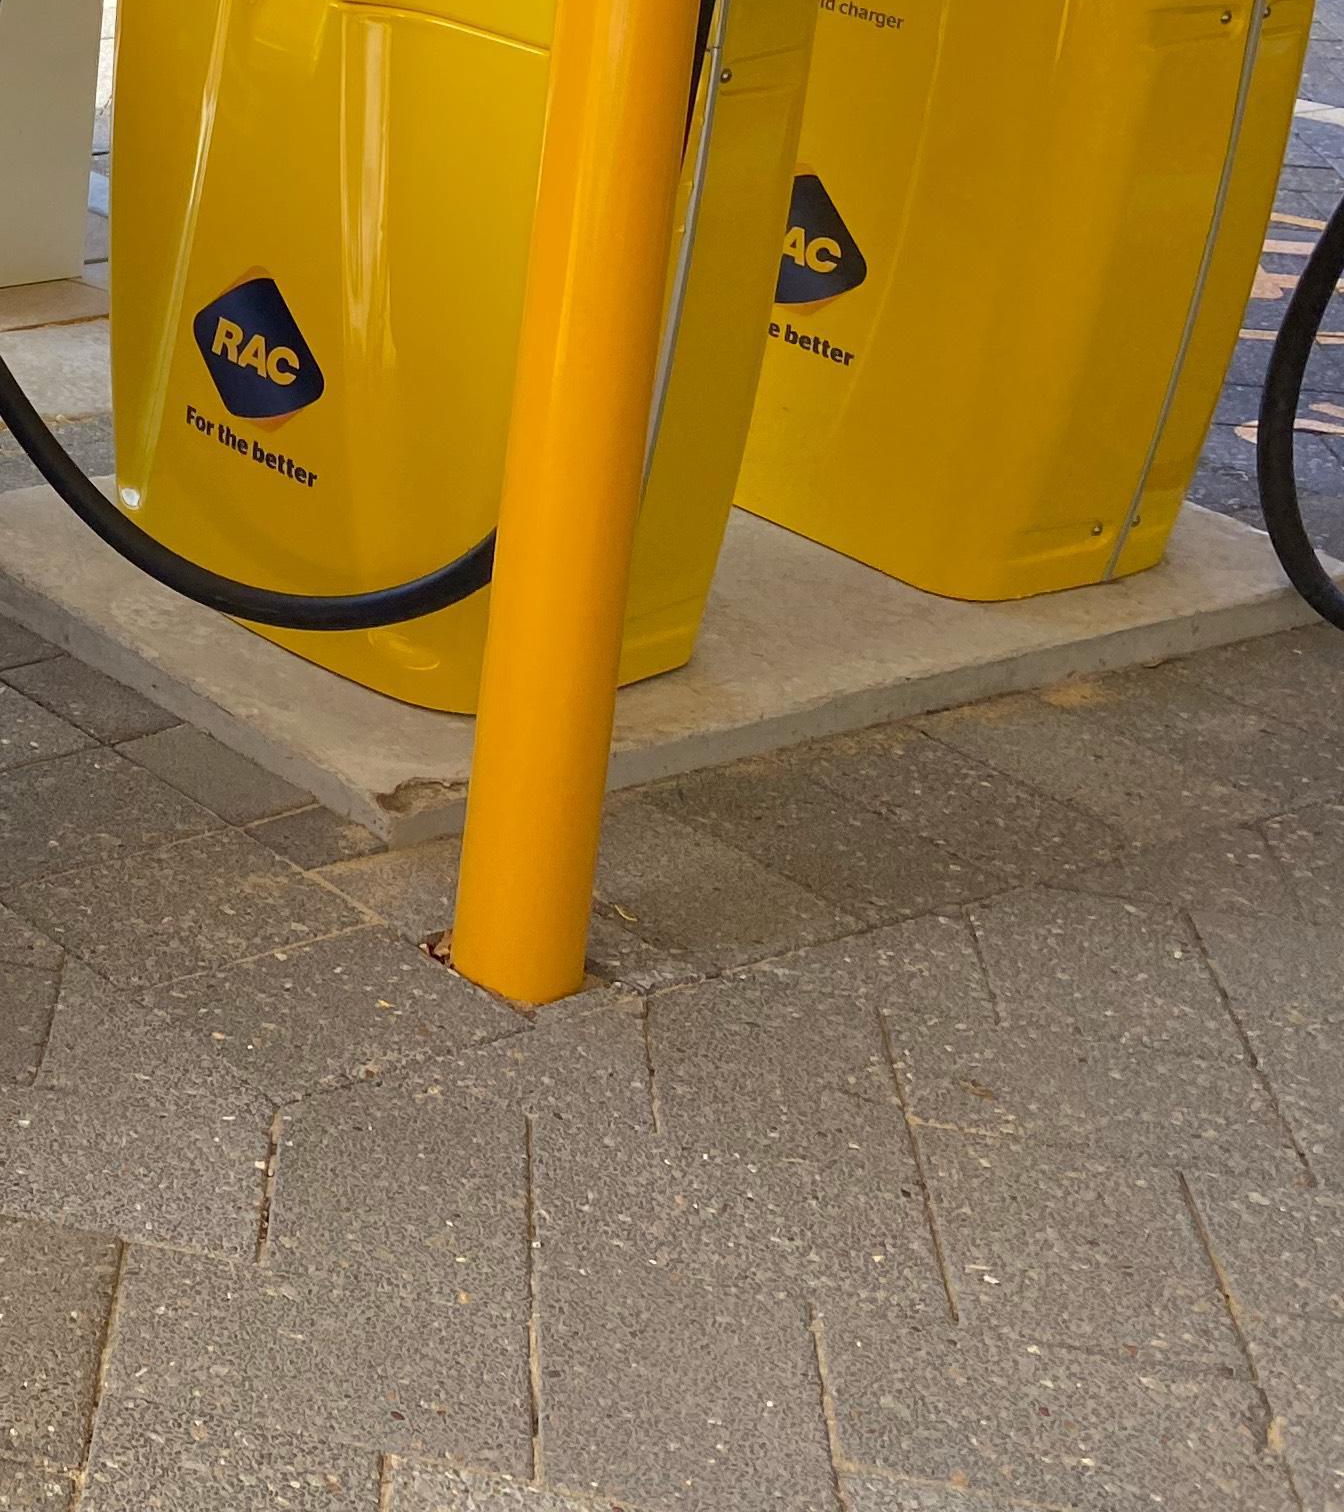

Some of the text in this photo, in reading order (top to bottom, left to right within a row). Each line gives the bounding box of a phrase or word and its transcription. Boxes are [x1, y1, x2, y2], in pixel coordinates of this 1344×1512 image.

[839, 0, 905, 31] charger
[783, 226, 842, 273] AC
[211, 316, 300, 386] RAC
[784, 325, 855, 367] better
[185, 404, 318, 488] For the better
